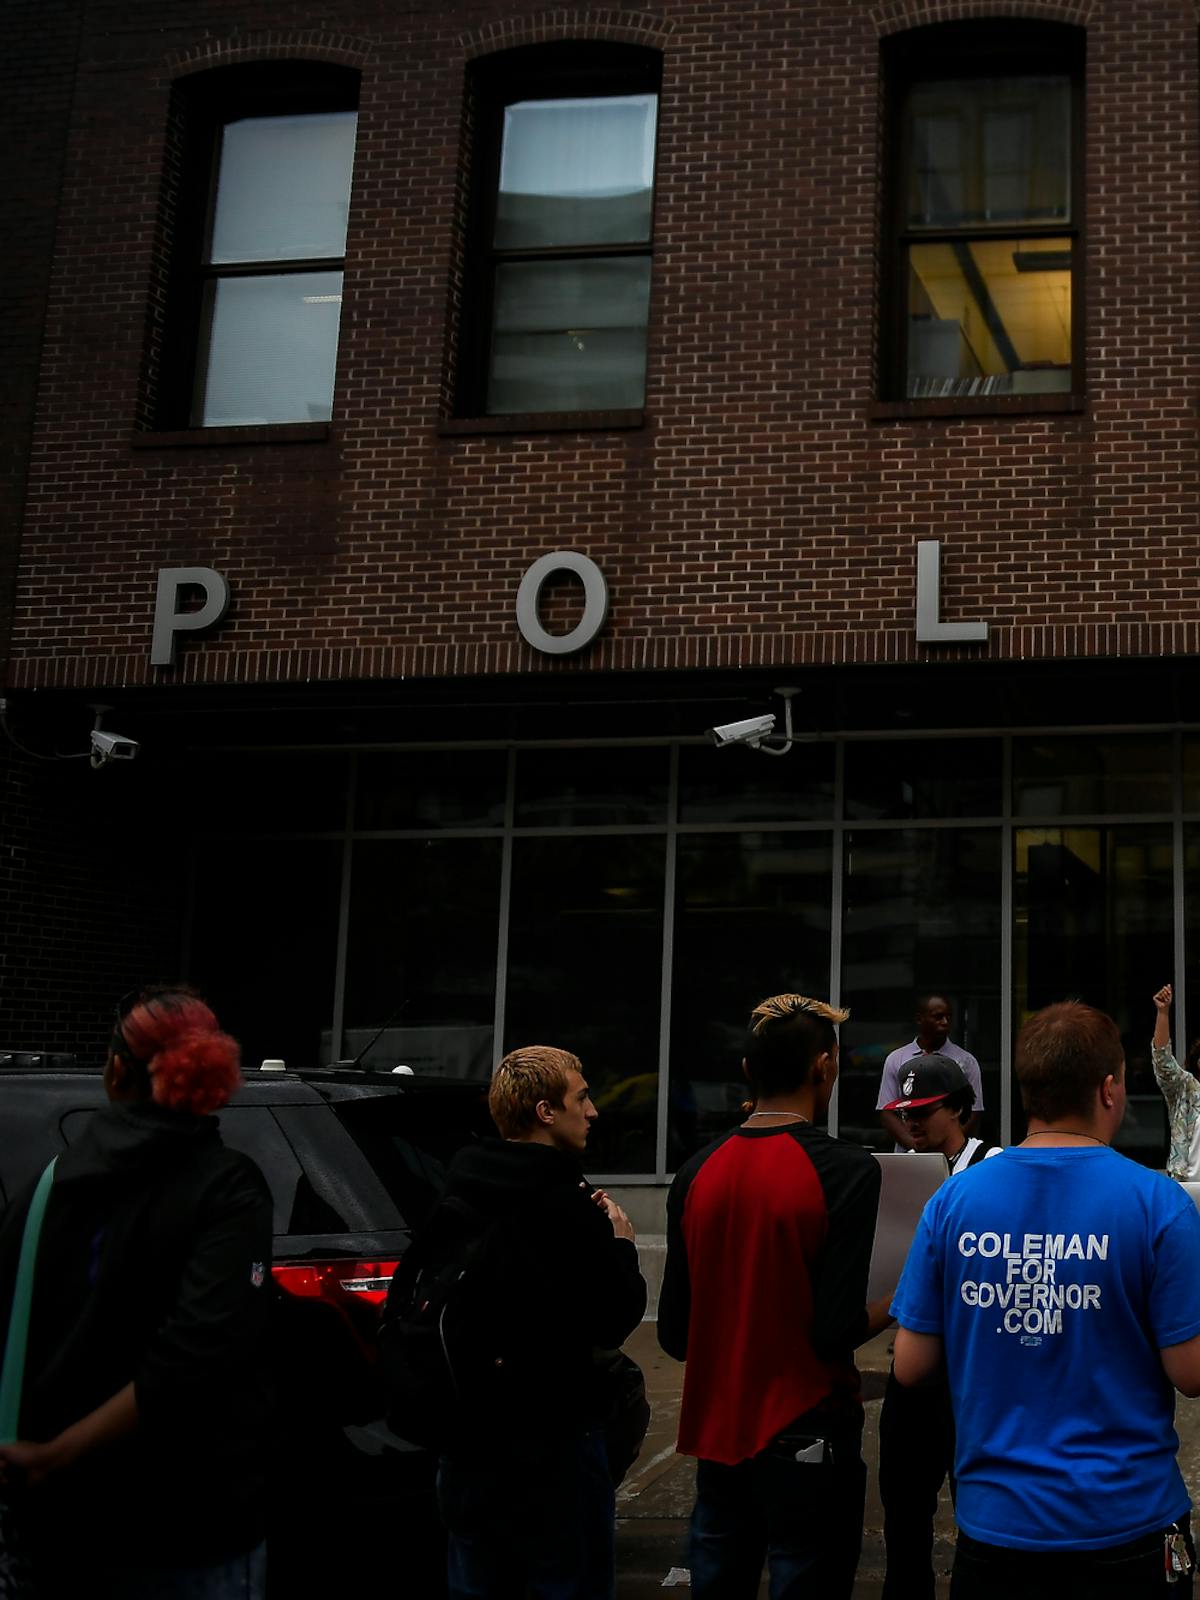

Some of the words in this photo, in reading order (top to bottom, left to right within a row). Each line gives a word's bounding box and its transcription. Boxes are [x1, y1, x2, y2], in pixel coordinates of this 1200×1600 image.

[958, 1231, 1109, 1260] COLEMAN
[1006, 1258, 1056, 1284] FOR
[961, 1280, 1102, 1310] GOVERNOR
[996, 1308, 1063, 1335] .COM
